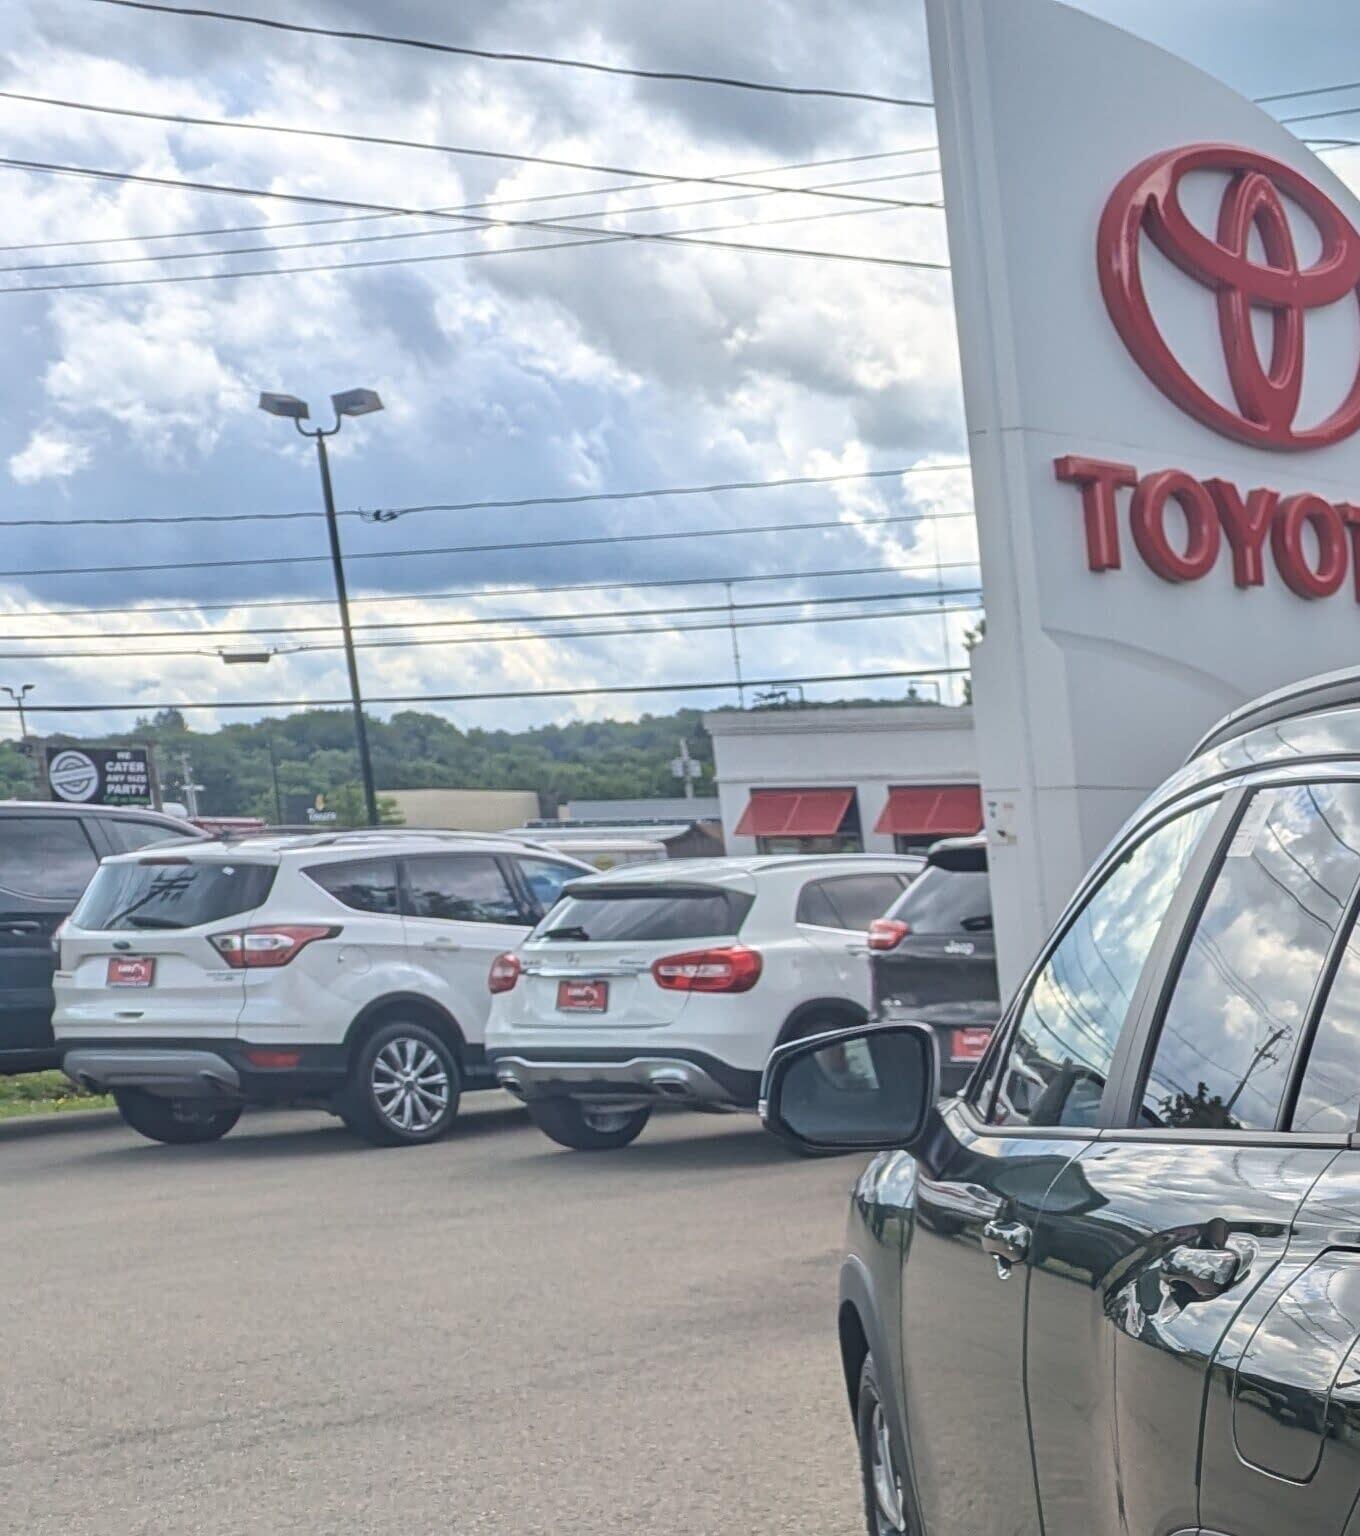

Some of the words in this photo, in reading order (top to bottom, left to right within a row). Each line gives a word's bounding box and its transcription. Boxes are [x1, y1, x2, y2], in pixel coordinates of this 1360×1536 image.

[105, 761, 146, 773] CATER
[105, 774, 126, 783] ANY
[127, 774, 147, 783] SIZE
[106, 784, 147, 795] PARTY
